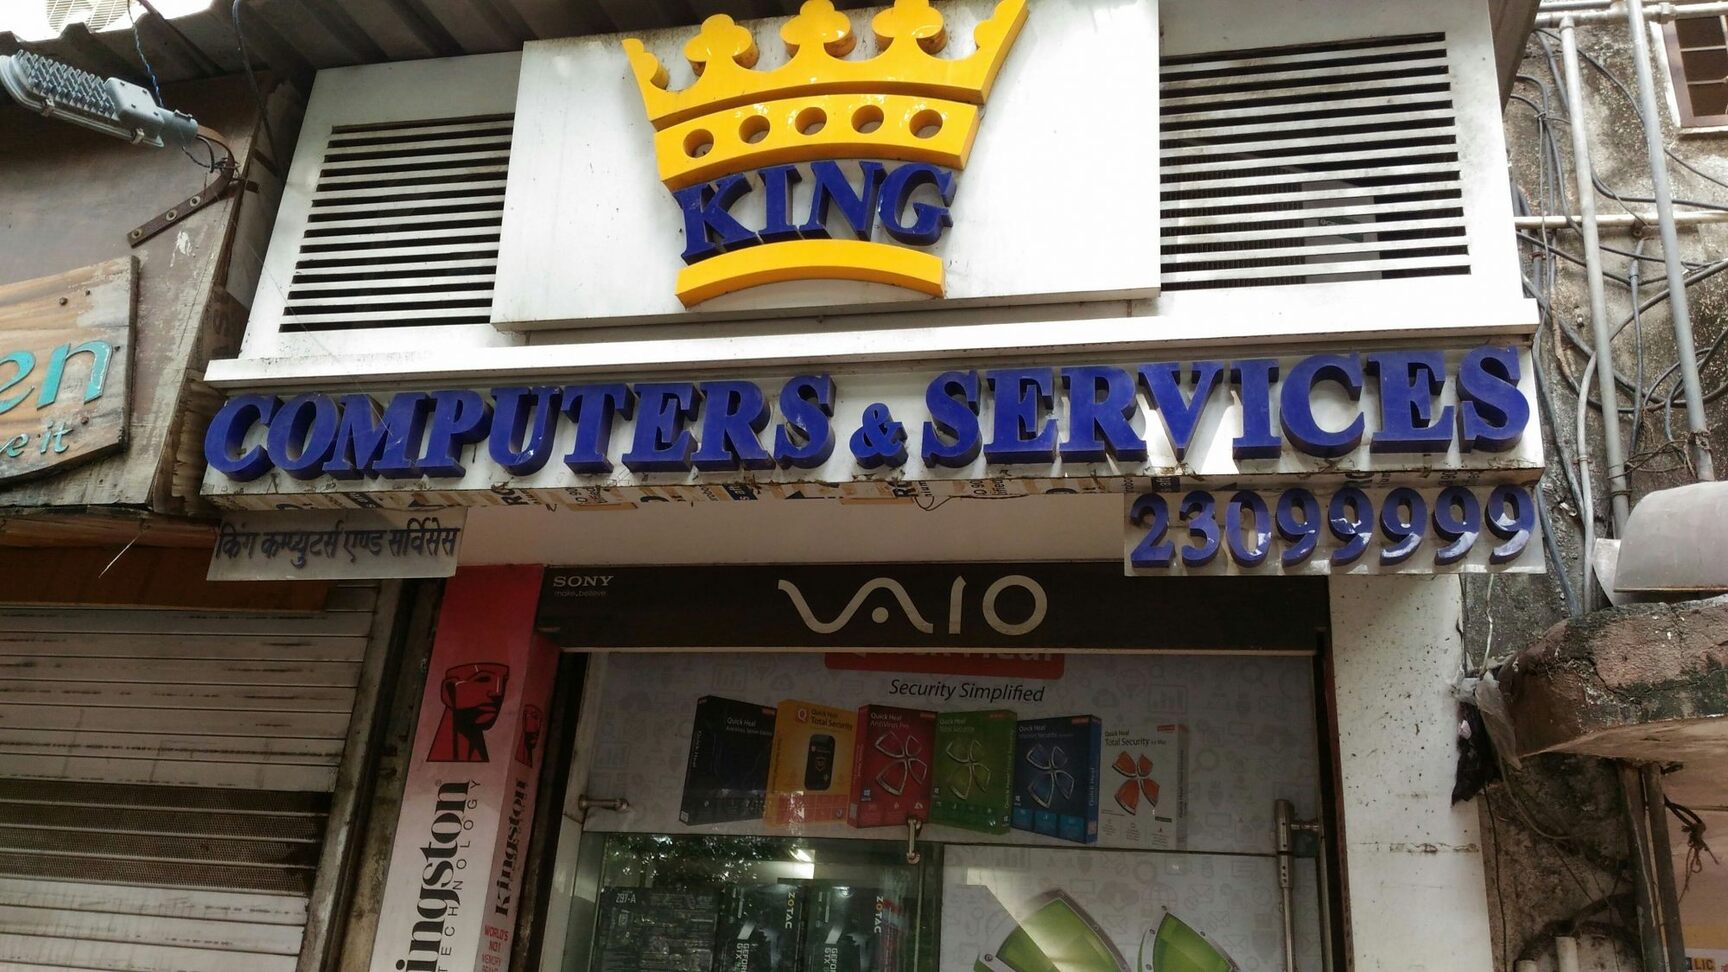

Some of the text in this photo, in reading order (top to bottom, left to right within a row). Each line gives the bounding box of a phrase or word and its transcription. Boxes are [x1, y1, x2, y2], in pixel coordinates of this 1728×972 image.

[672, 160, 957, 266] KING
[204, 345, 1531, 481] COMPUTERS & SERVICES
[40, 420, 75, 454] it
[216, 521, 260, 560] किंग
[343, 529, 388, 563] एण्ड
[388, 517, 461, 558] सर्विसेस
[1129, 483, 1537, 569] 23099999
[553, 575, 615, 588] SONY
[778, 575, 1048, 636] VAIO
[889, 679, 1045, 703] Security Simplified
[1105, 738, 1121, 746] Total
[1121, 738, 1151, 747] Security
[495, 778, 527, 916] Kingston
[437, 780, 481, 972] TECHNOLOGY
[785, 892, 796, 929] ZOTAC
[874, 896, 884, 934] ZOTAC
[740, 943, 750, 972] GEFOR
